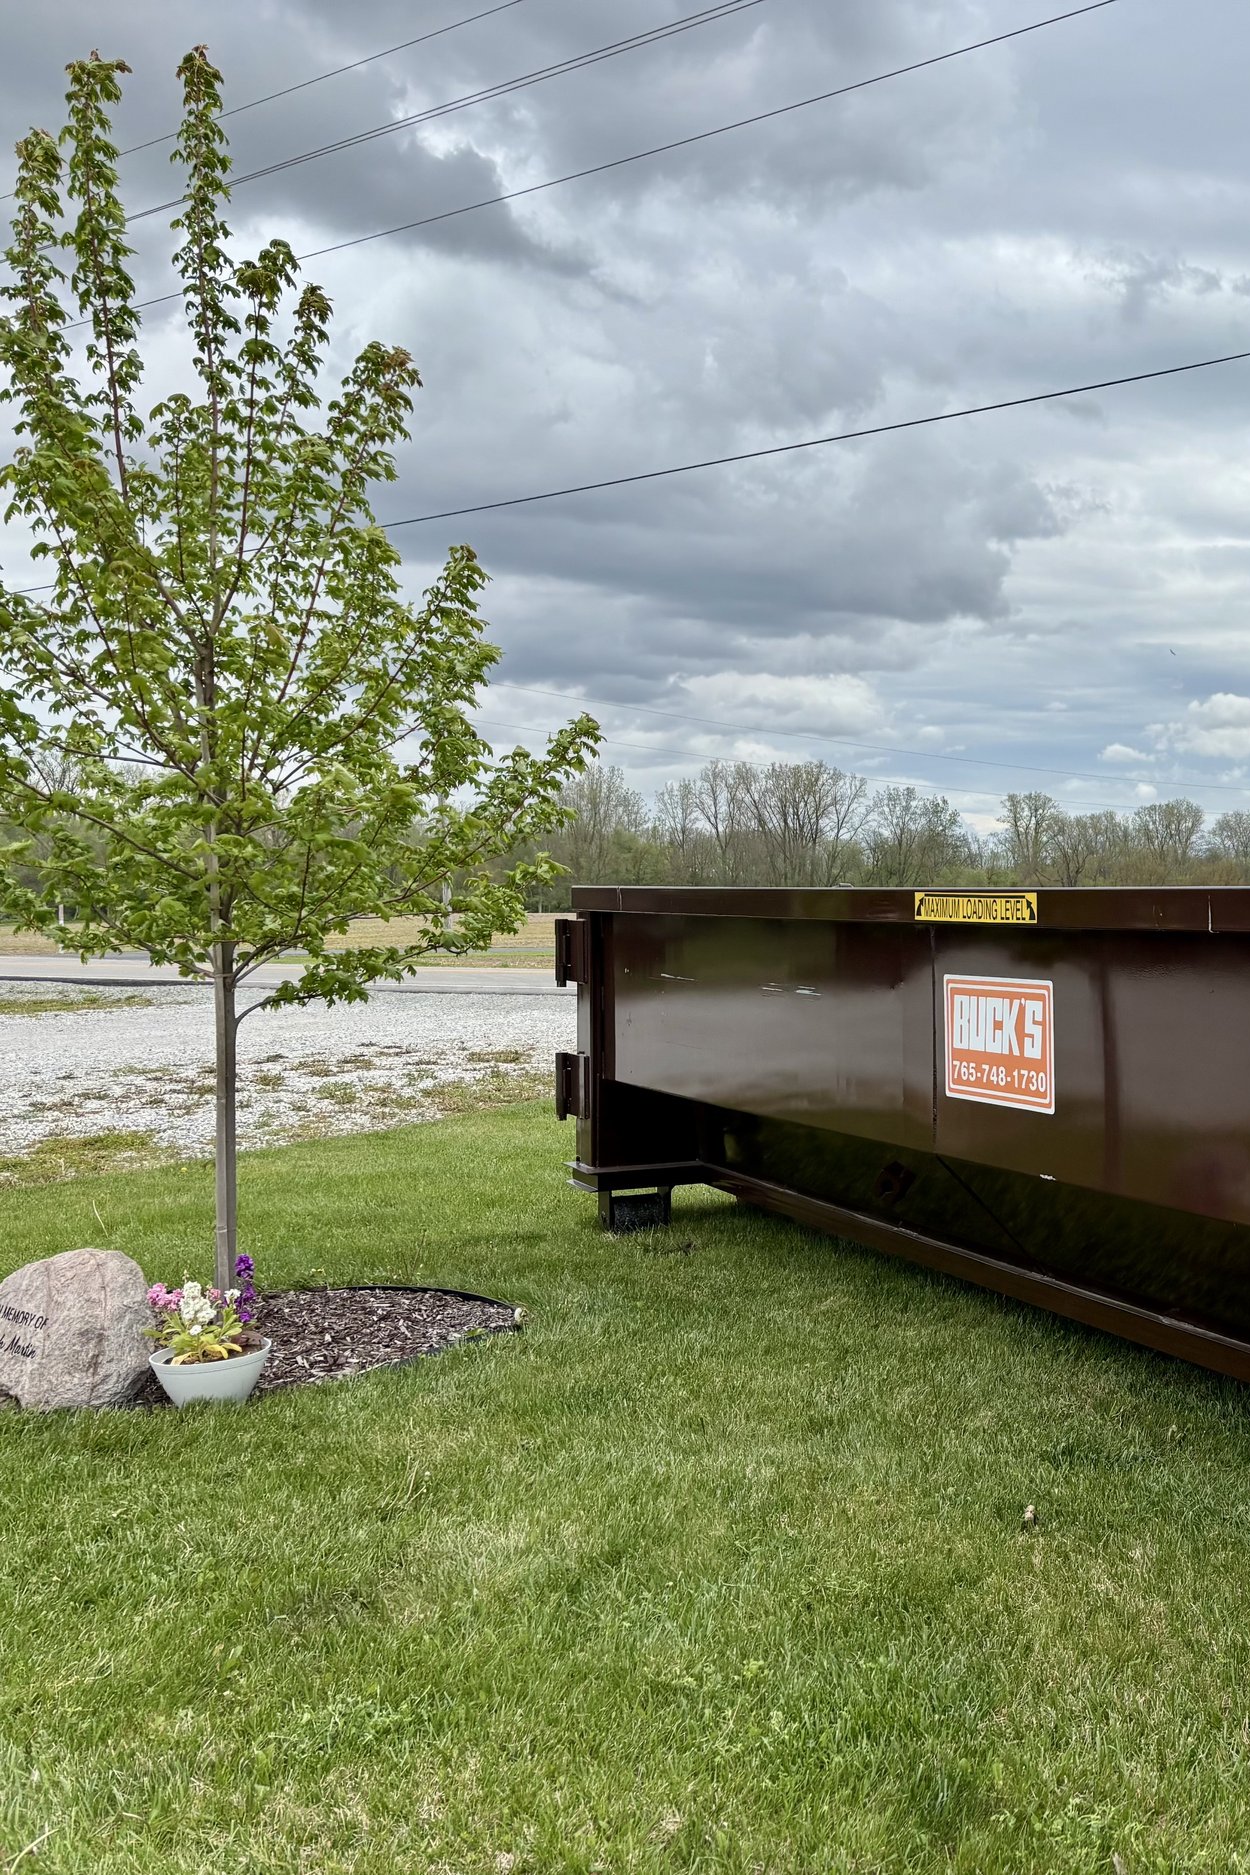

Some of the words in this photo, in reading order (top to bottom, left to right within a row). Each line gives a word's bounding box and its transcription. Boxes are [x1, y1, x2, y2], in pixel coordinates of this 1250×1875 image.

[924, 898, 960, 918] MAXIMUM
[962, 899, 997, 920] LOADING
[1000, 900, 1026, 920] LEVEL
[953, 994, 1043, 1059] BUCK'S
[953, 1060, 1046, 1092] 765-748-1730
[1, 1305, 36, 1326] MEMORY
[34, 1315, 49, 1330] OF
[4, 1334, 36, 1359] Martin
